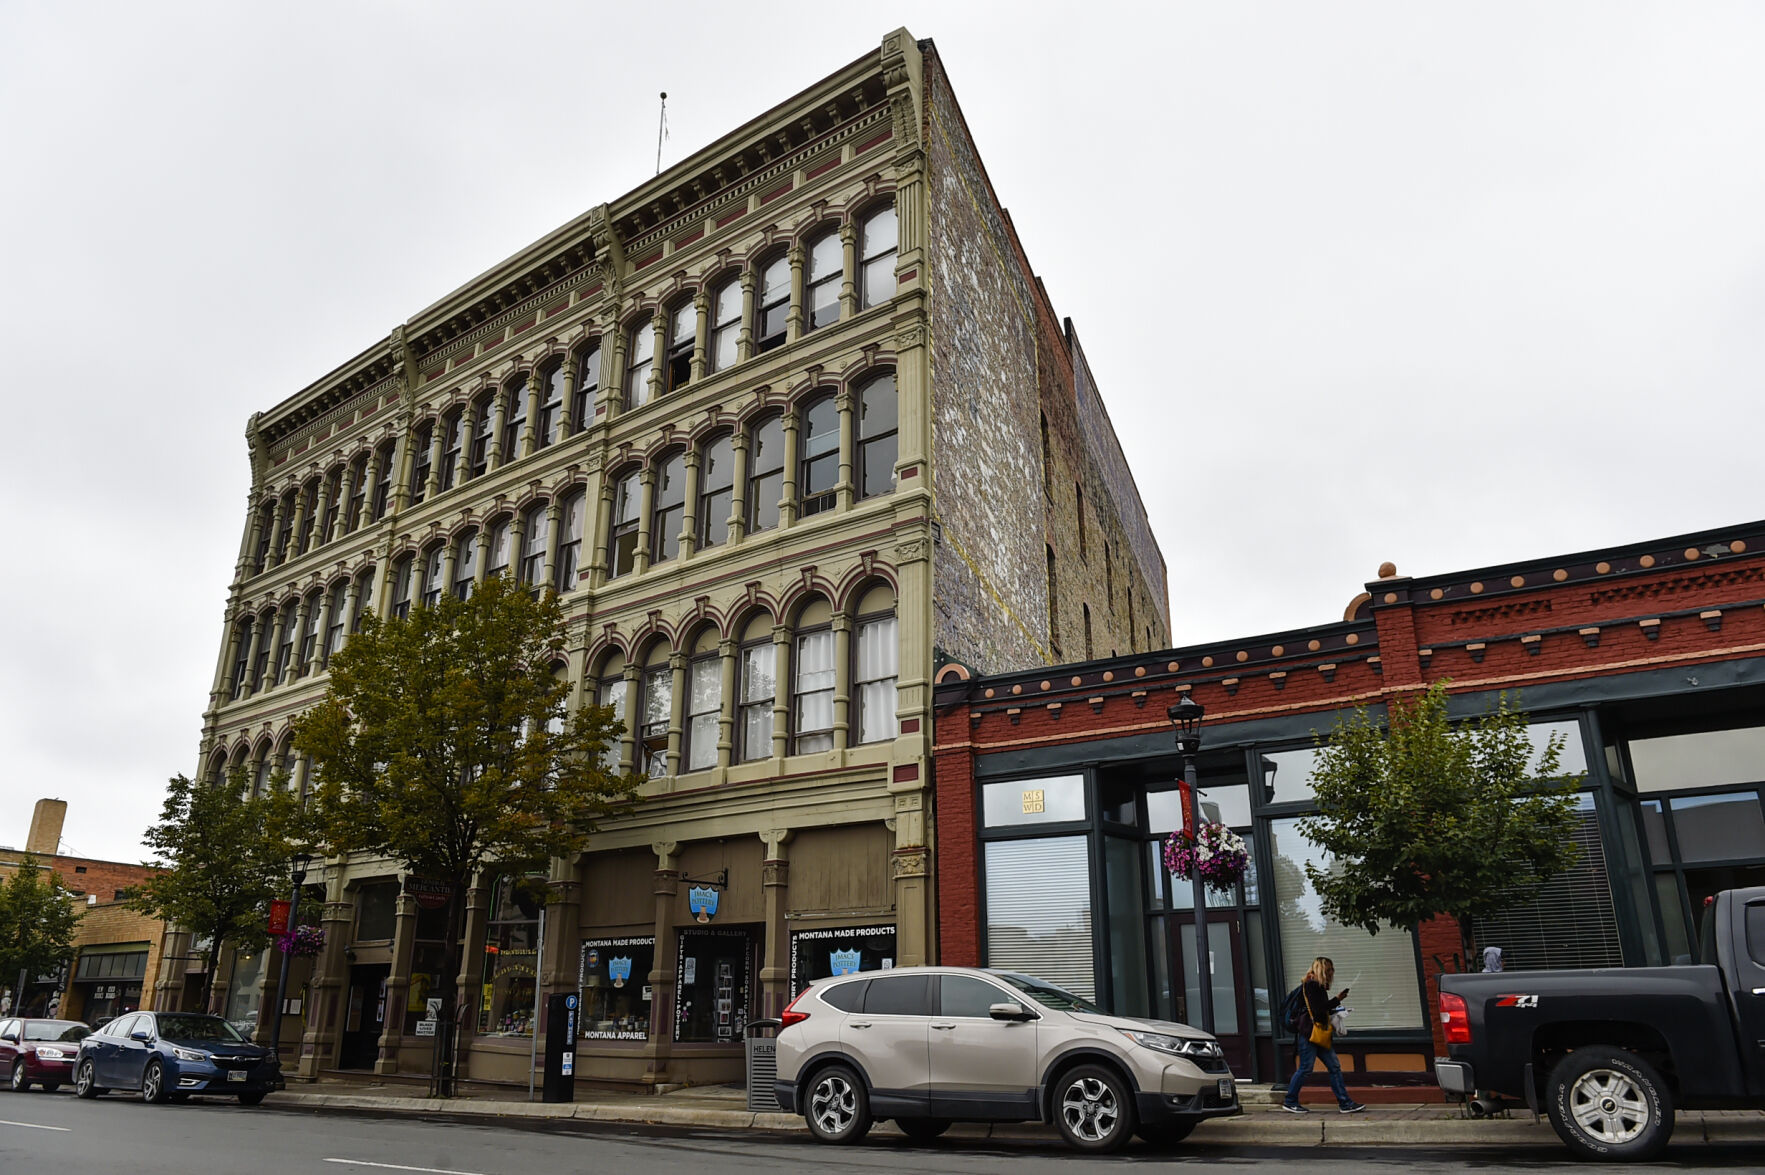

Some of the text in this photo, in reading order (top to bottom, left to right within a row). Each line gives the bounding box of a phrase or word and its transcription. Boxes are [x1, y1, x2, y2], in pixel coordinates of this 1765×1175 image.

[692, 897, 715, 906] POTTERY
[798, 926, 895, 940] MONTANA MADE PRODUCTS
[585, 940, 612, 948] MONTANA
[612, 938, 628, 946] MADE
[833, 960, 857, 968] POTTERY
[569, 997, 575, 1008] P
[1496, 993, 1539, 1008] Z71
[585, 1031, 647, 1040] MONTANA APPAREL
[1557, 1083, 1609, 1153] GOODYEAR
